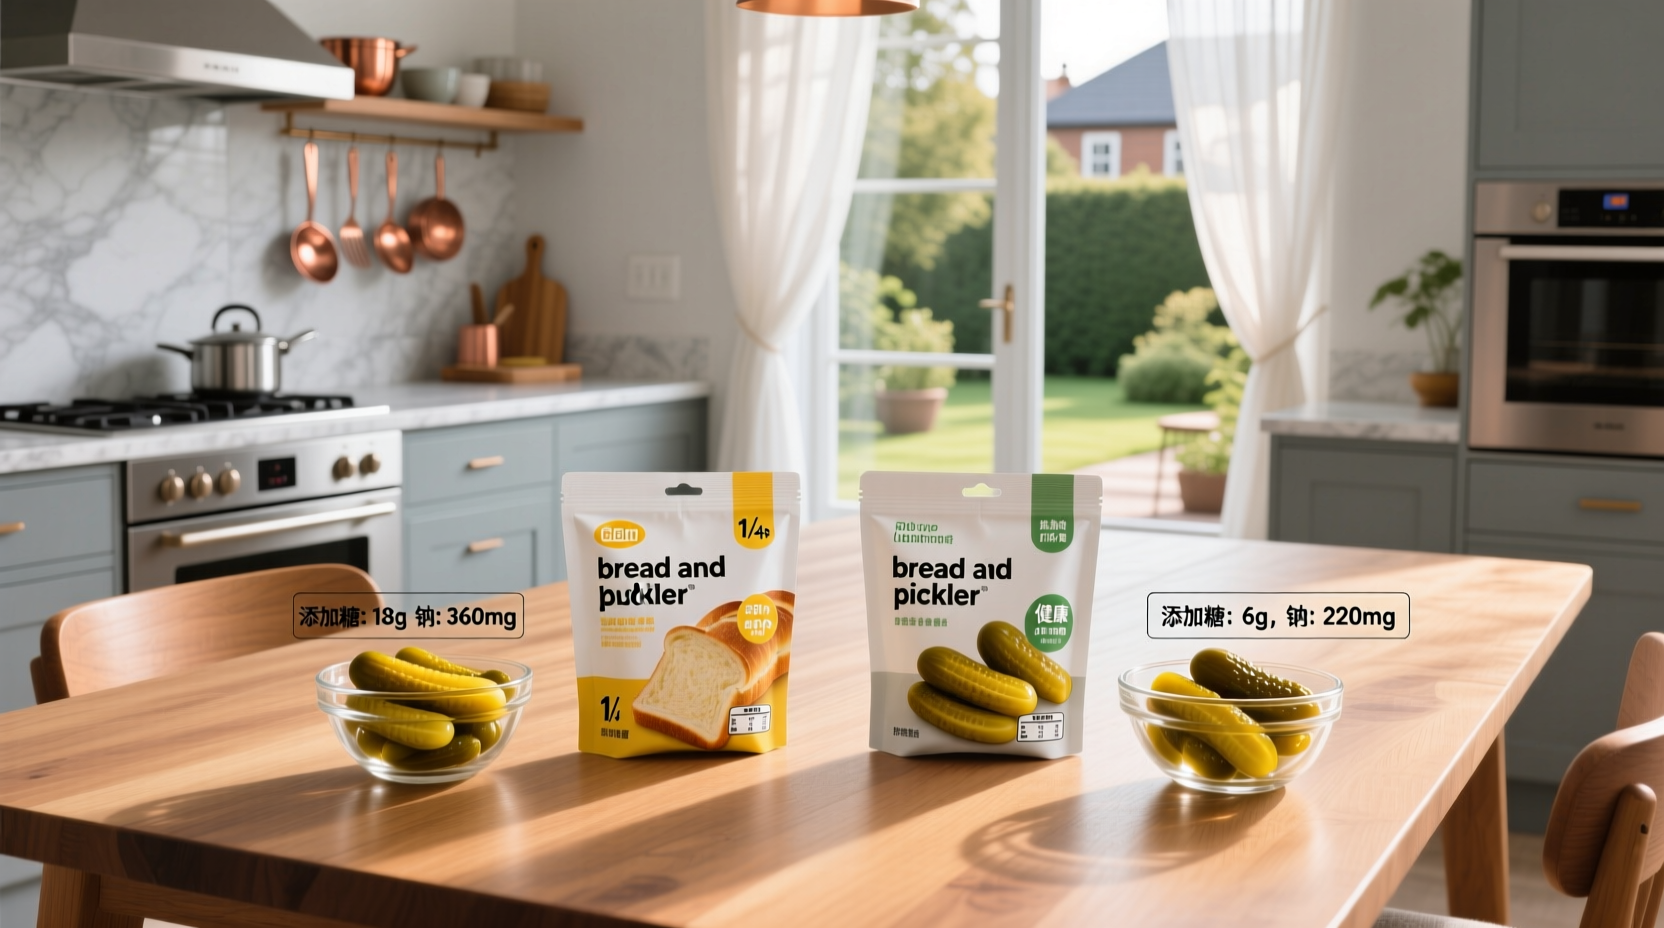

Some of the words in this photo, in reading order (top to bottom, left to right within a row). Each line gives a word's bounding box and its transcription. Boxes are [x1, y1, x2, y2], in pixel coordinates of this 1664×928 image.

[597, 556, 671, 580] bread
[677, 555, 726, 579] and
[892, 555, 965, 579] bread
[894, 582, 981, 611] pickler
[1034, 603, 1069, 624] 健康
